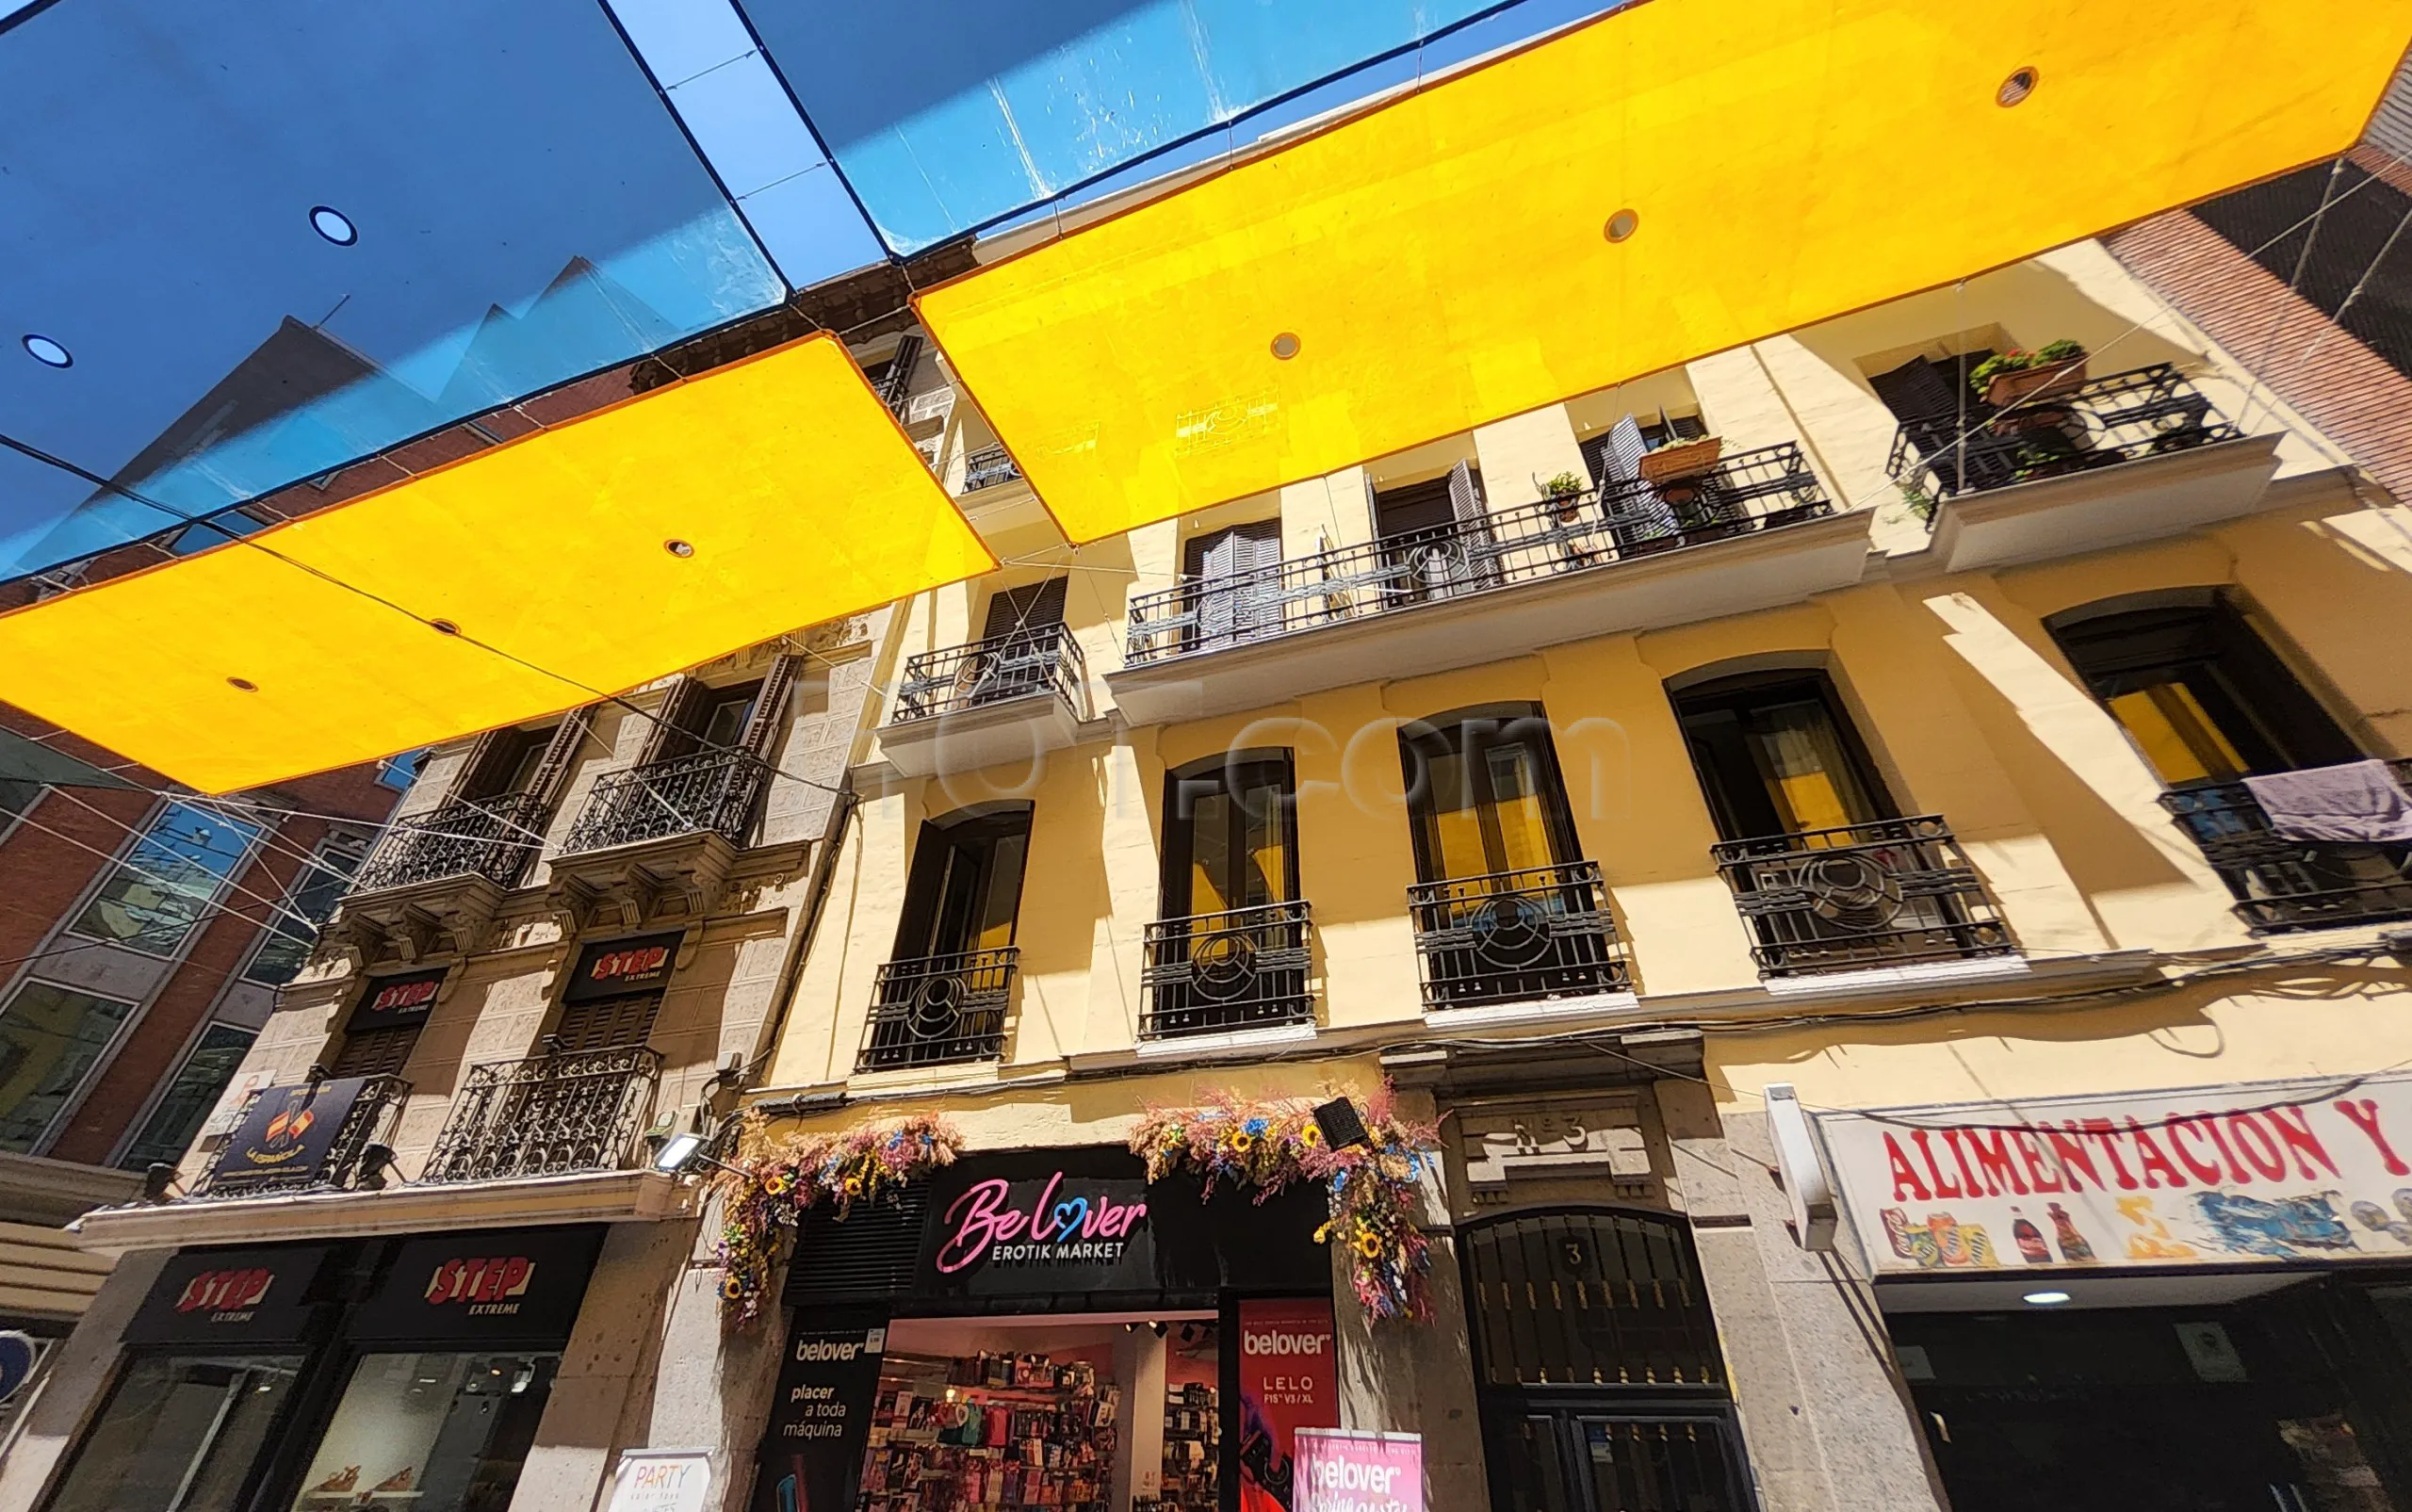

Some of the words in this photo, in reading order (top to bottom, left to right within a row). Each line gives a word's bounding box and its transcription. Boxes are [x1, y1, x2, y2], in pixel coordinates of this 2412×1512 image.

[590, 946, 670, 981] STEP
[624, 970, 662, 983] EXTREME
[372, 980, 440, 1012] STEP
[397, 1002, 430, 1016] EXTREME
[1561, 1115, 1589, 1148] 3
[1881, 1105, 2344, 1202] ALIMENTACION
[2332, 1098, 2411, 1178] Y
[991, 1244, 1052, 1261] EROTIK
[1055, 1242, 1125, 1260] MARKET
[1565, 1242, 1583, 1266] 3
[174, 1266, 276, 1313] STEP
[423, 1256, 537, 1307] STEP
[209, 1309, 255, 1324] EXTREME
[466, 1302, 521, 1317] EXTREME
[795, 1338, 859, 1362] belover
[1243, 1329, 1327, 1356] belover
[790, 1383, 836, 1404] placer
[1263, 1375, 1313, 1391] LELO
[805, 1405, 814, 1418] a
[816, 1401, 847, 1419] toda
[782, 1420, 843, 1441] máquina
[633, 1463, 693, 1489] PARTY
[1310, 1453, 1396, 1496] belover
